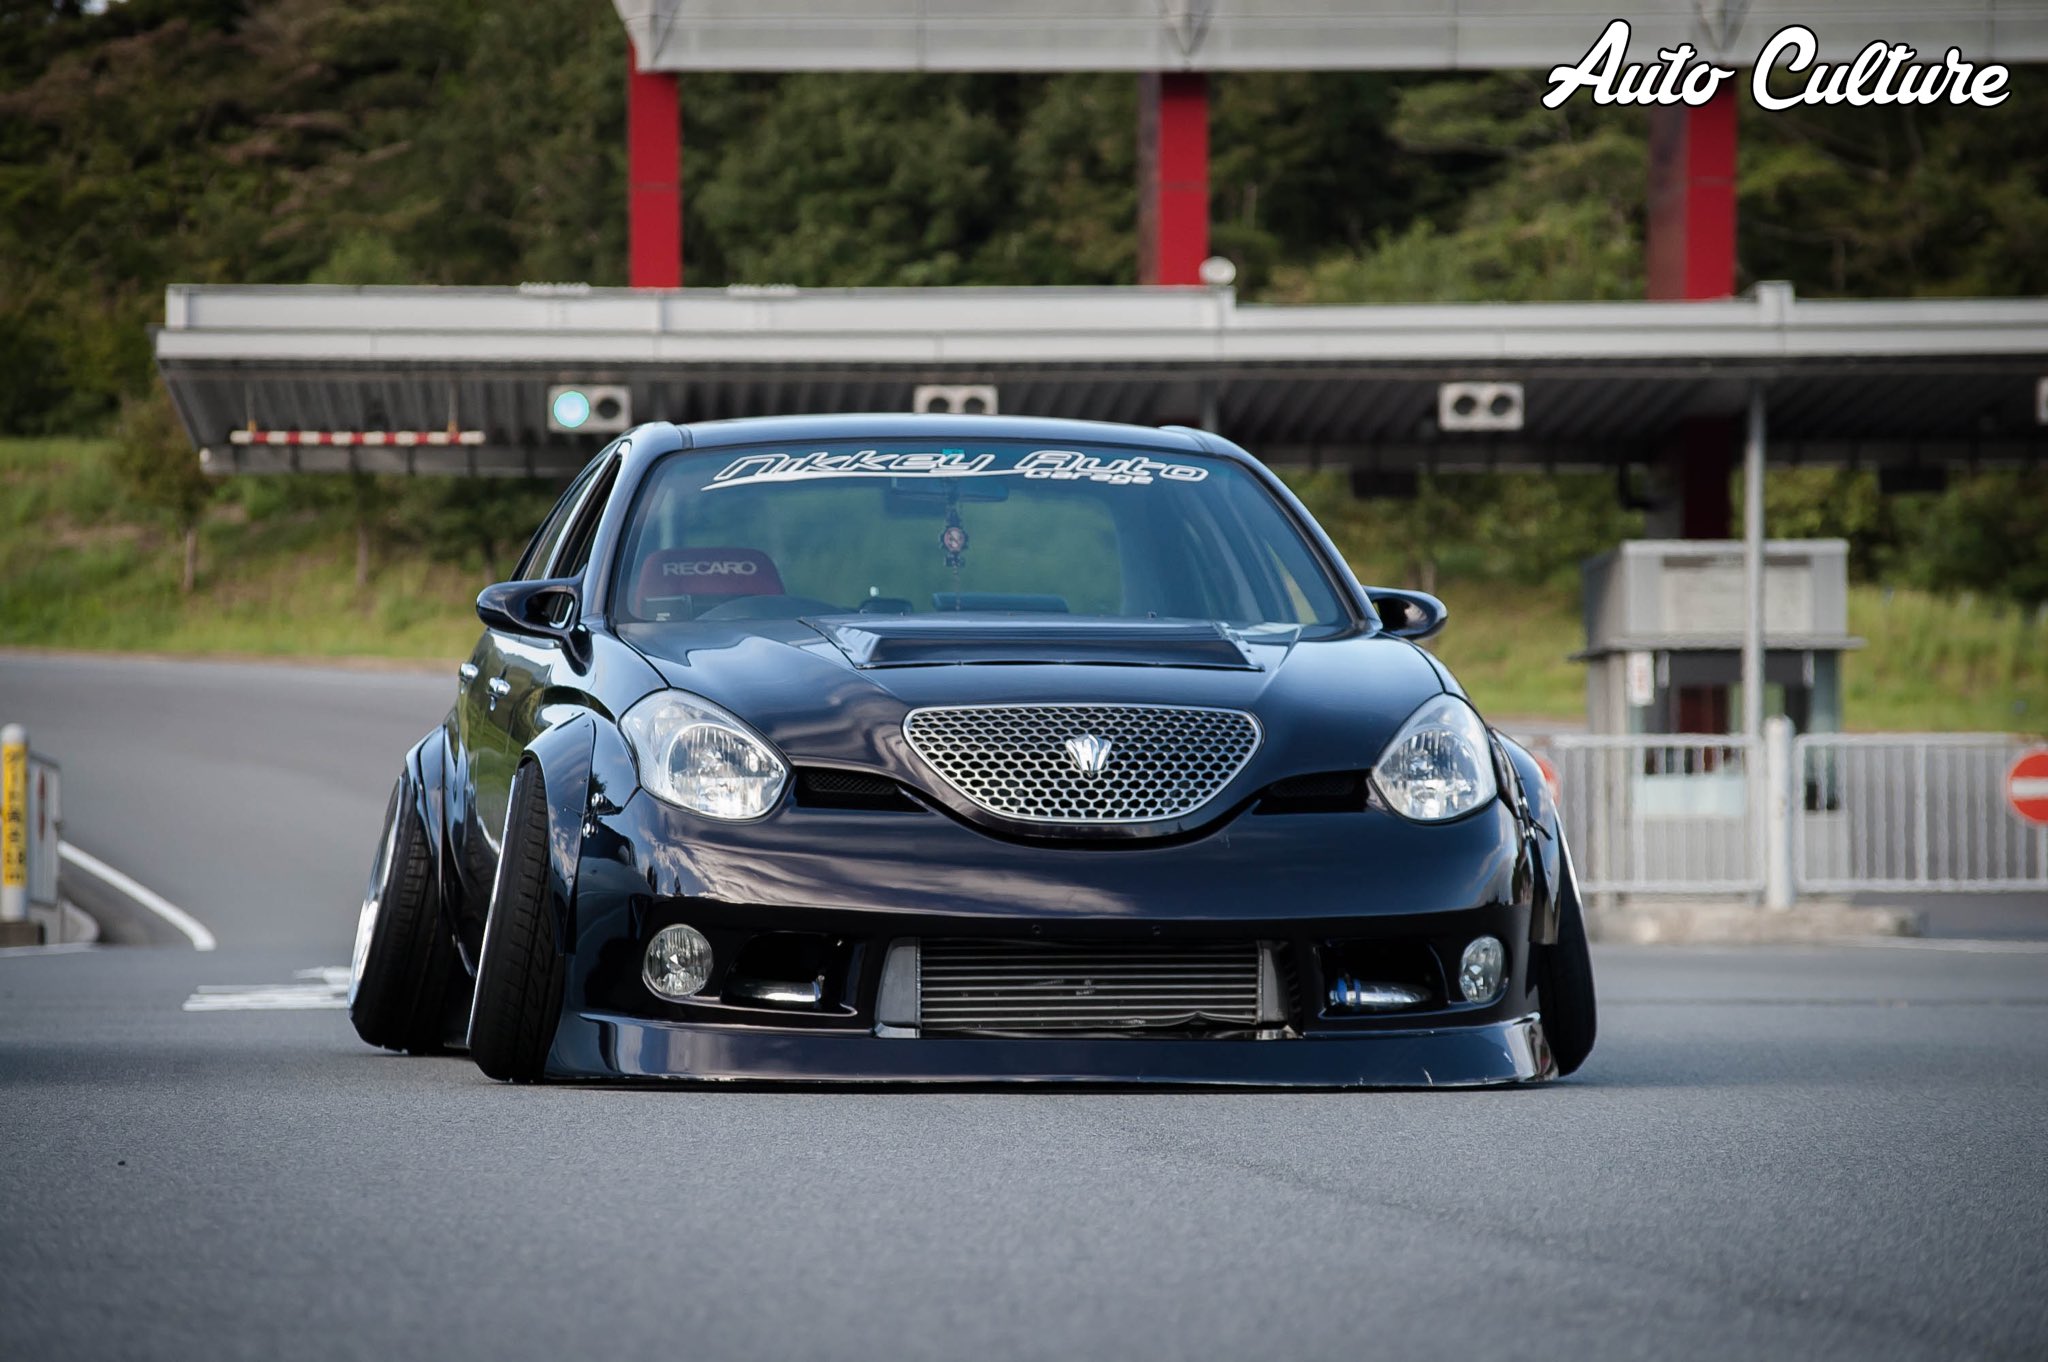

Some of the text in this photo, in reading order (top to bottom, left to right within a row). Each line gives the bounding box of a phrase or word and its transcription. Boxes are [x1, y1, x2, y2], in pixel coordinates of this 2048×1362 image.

[1014, 450, 1209, 482] Auto
[1024, 468, 1154, 485] Garage
[661, 560, 758, 576] RECARO
